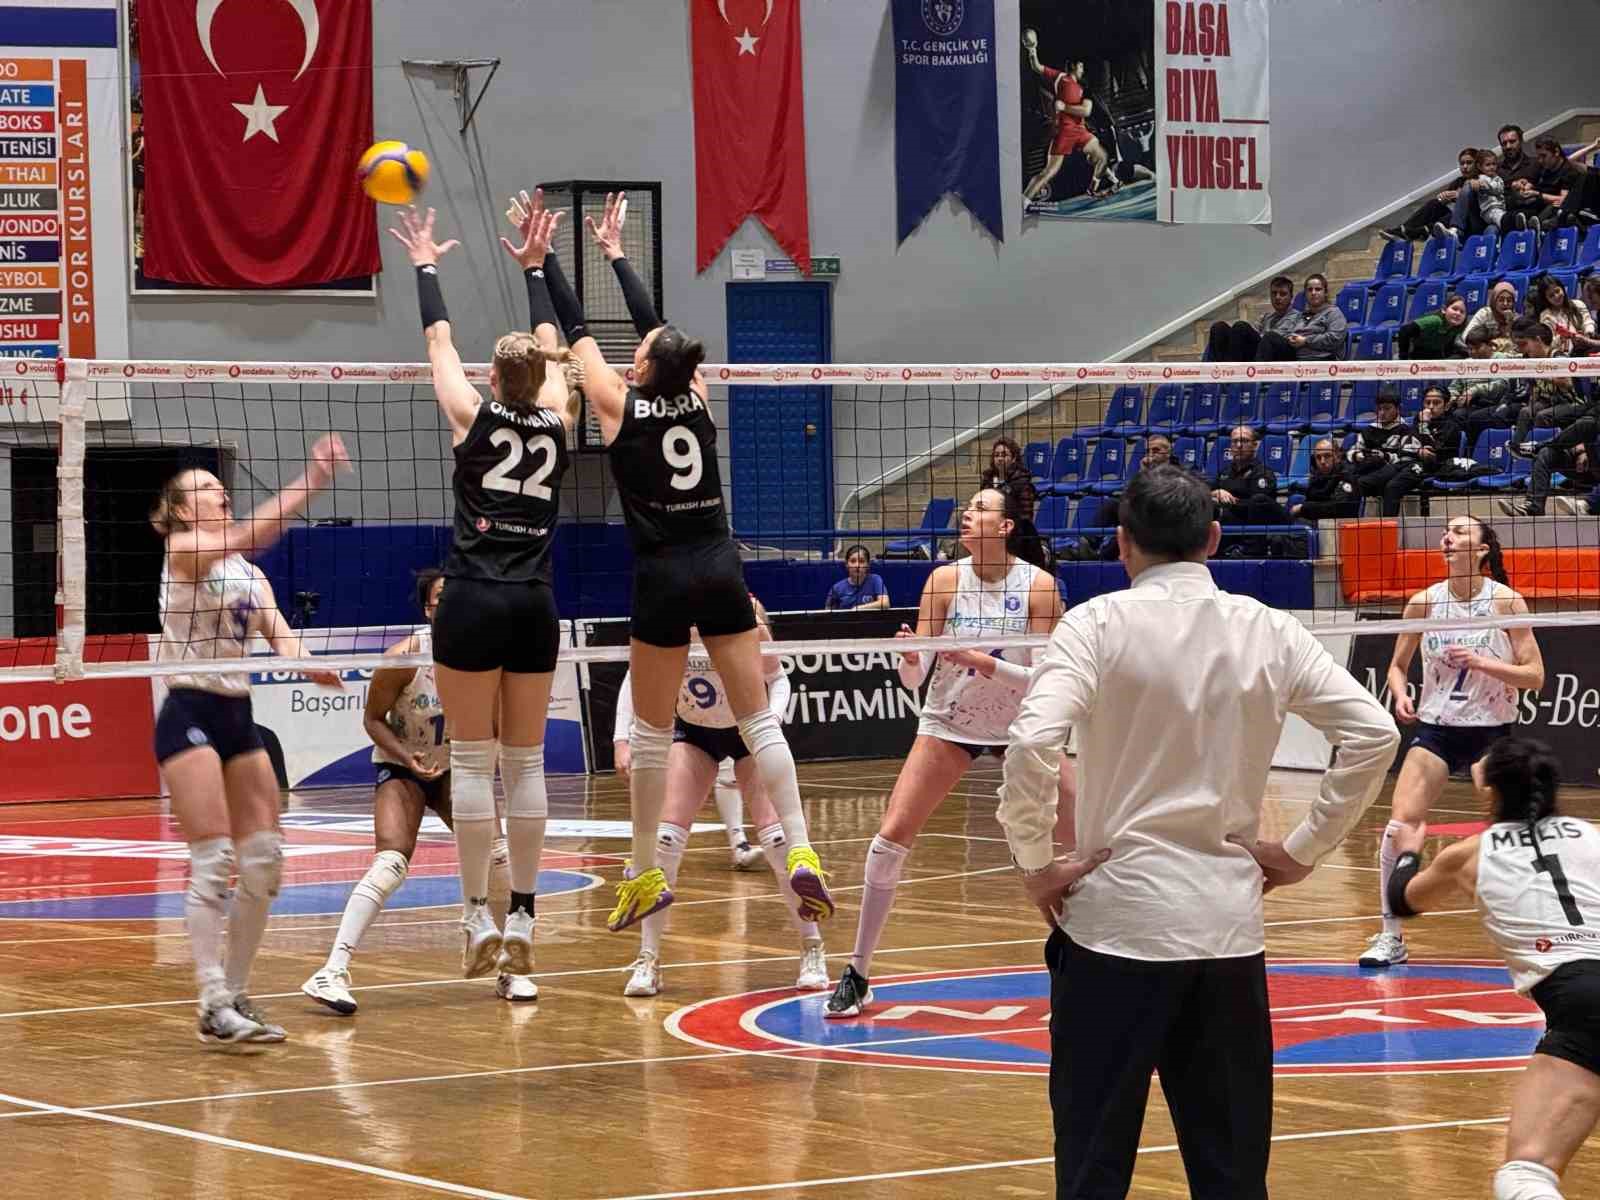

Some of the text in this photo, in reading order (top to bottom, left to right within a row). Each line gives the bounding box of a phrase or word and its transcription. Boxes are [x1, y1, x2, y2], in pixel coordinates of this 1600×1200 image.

[923, 38, 969, 54] GENÇLİK
[971, 38, 987, 49] VE
[1166, 1, 1231, 62] BAŞA
[903, 50, 988, 66] SPOR BAKANLIĞI
[1166, 68, 1220, 123] RIYA
[2, 138, 52, 155] TENİSİ
[1166, 130, 1262, 190] YÜKSEL
[5, 167, 46, 181] THAI
[65, 101, 89, 323] SPOR KURSLARI
[137, 367, 171, 375] vodafone
[481, 428, 557, 501] 22
[661, 425, 703, 490] 9
[688, 677, 717, 709] 9
[0, 703, 92, 741] one
[1531, 853, 1585, 926] 1
